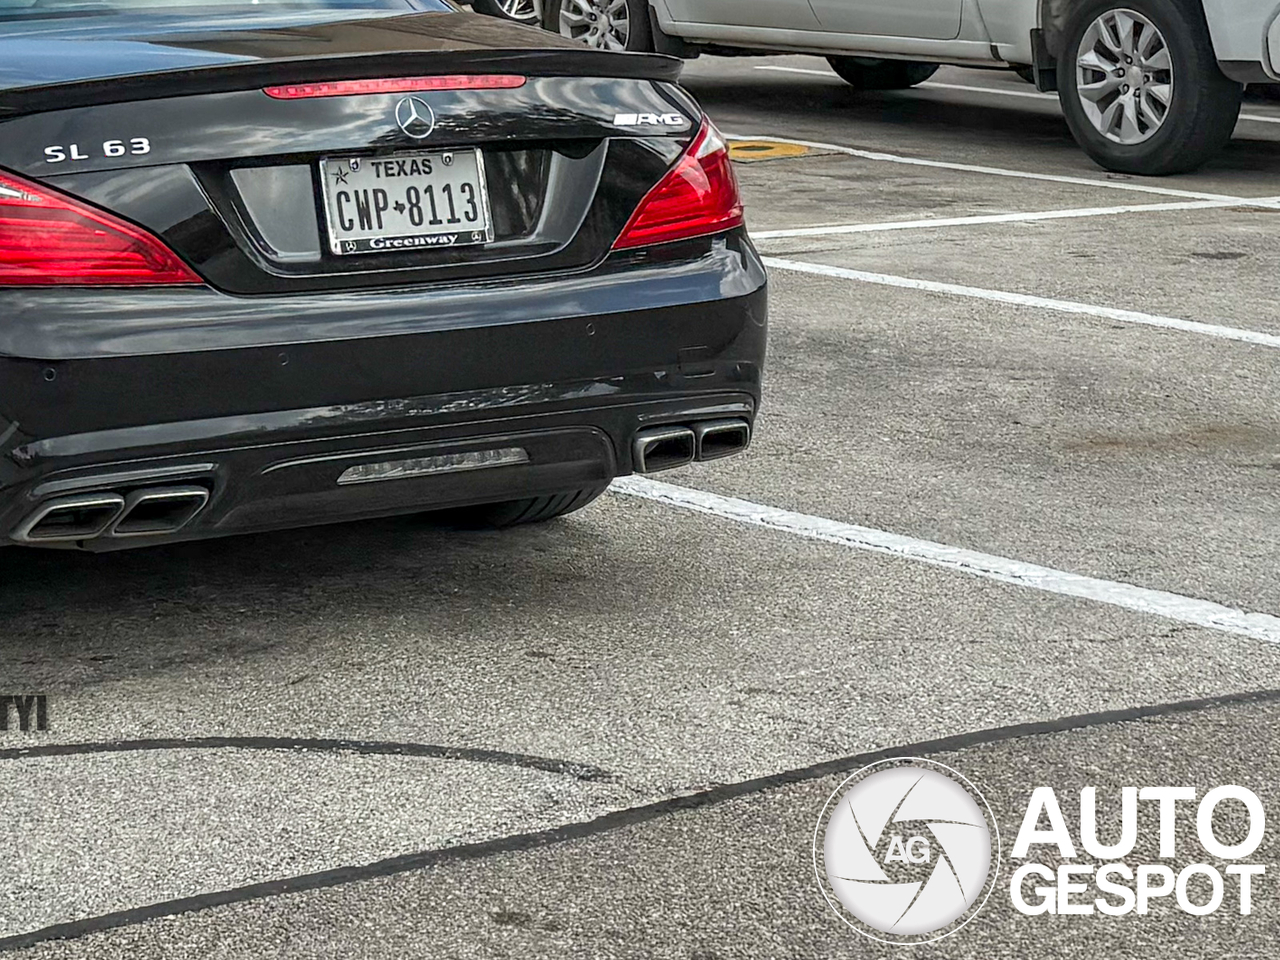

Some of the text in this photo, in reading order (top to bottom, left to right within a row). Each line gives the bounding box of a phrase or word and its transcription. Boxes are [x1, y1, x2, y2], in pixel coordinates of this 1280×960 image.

[44, 137, 151, 162] SL 63
[371, 158, 433, 178] TEXAS
[369, 233, 459, 250] Greenway
